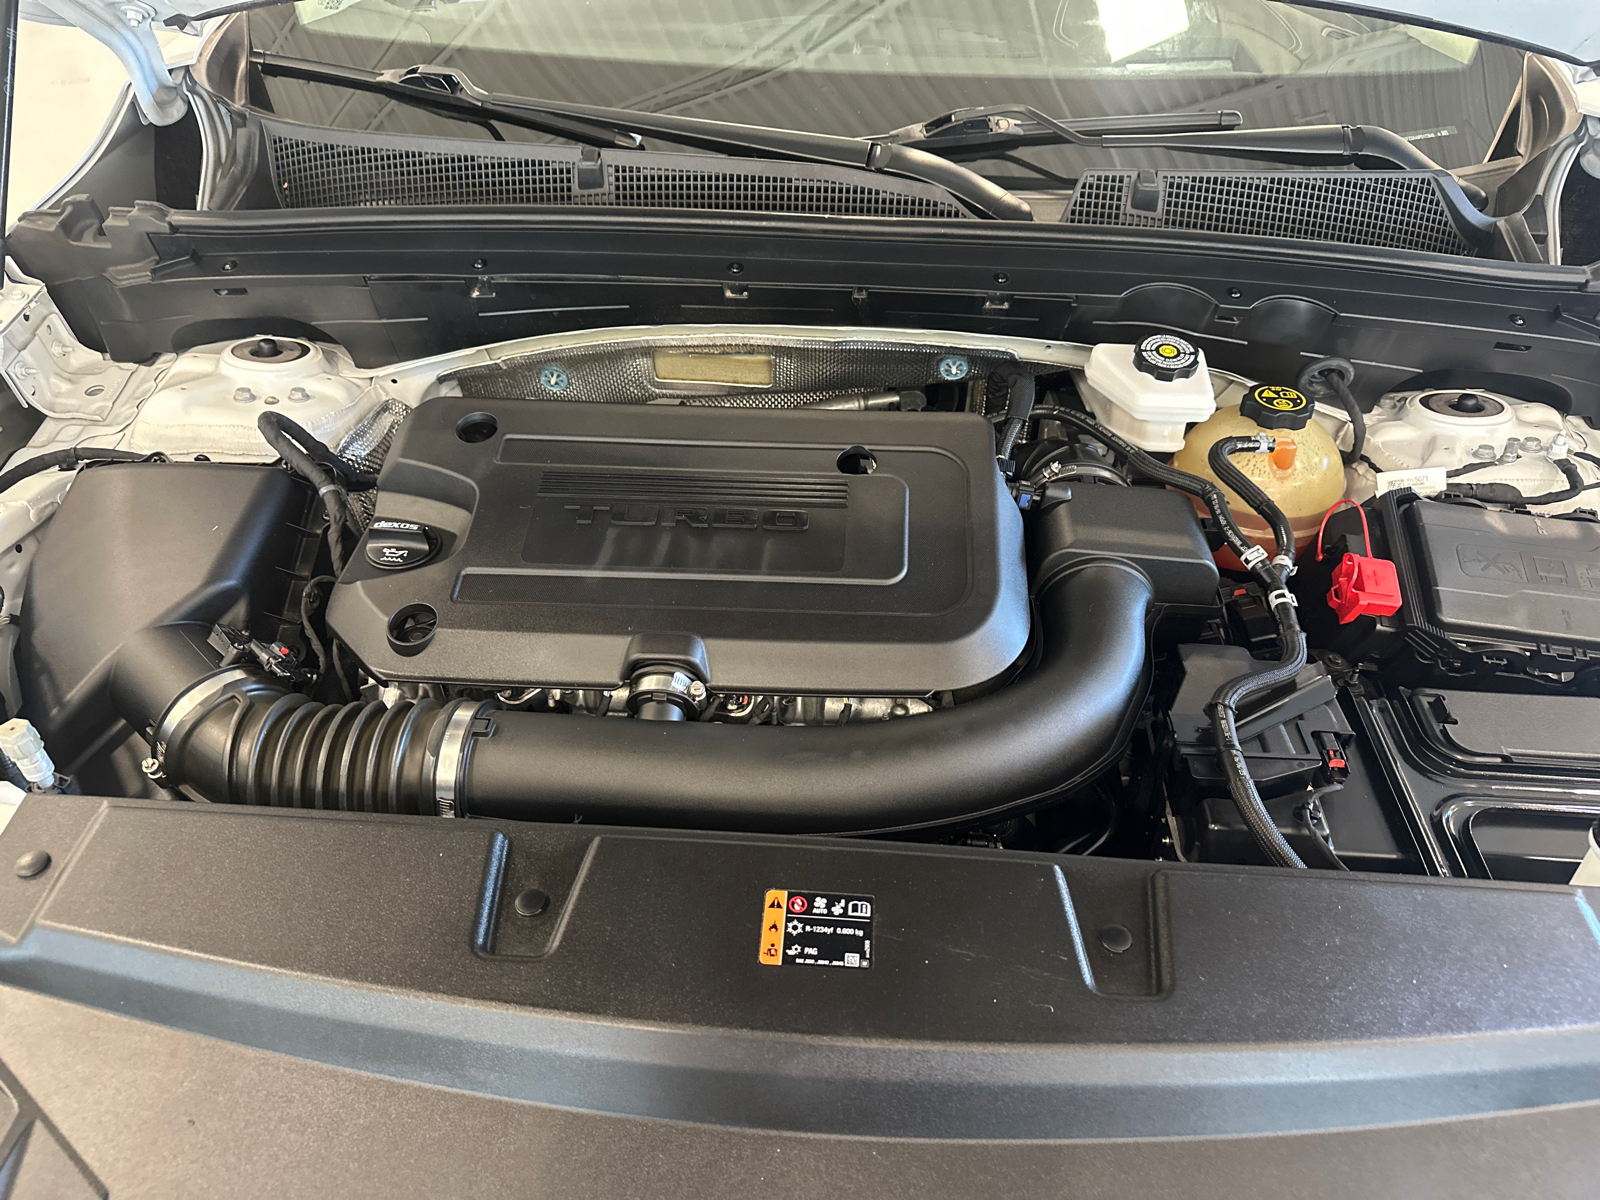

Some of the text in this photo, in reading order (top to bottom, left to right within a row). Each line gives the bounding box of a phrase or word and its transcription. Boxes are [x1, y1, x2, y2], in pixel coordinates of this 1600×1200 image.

[564, 503, 810, 531] TURBO
[373, 520, 420, 530] dexos
[805, 925, 834, 935] R-1234yf
[855, 928, 864, 937] kg
[804, 946, 818, 955] PAG
